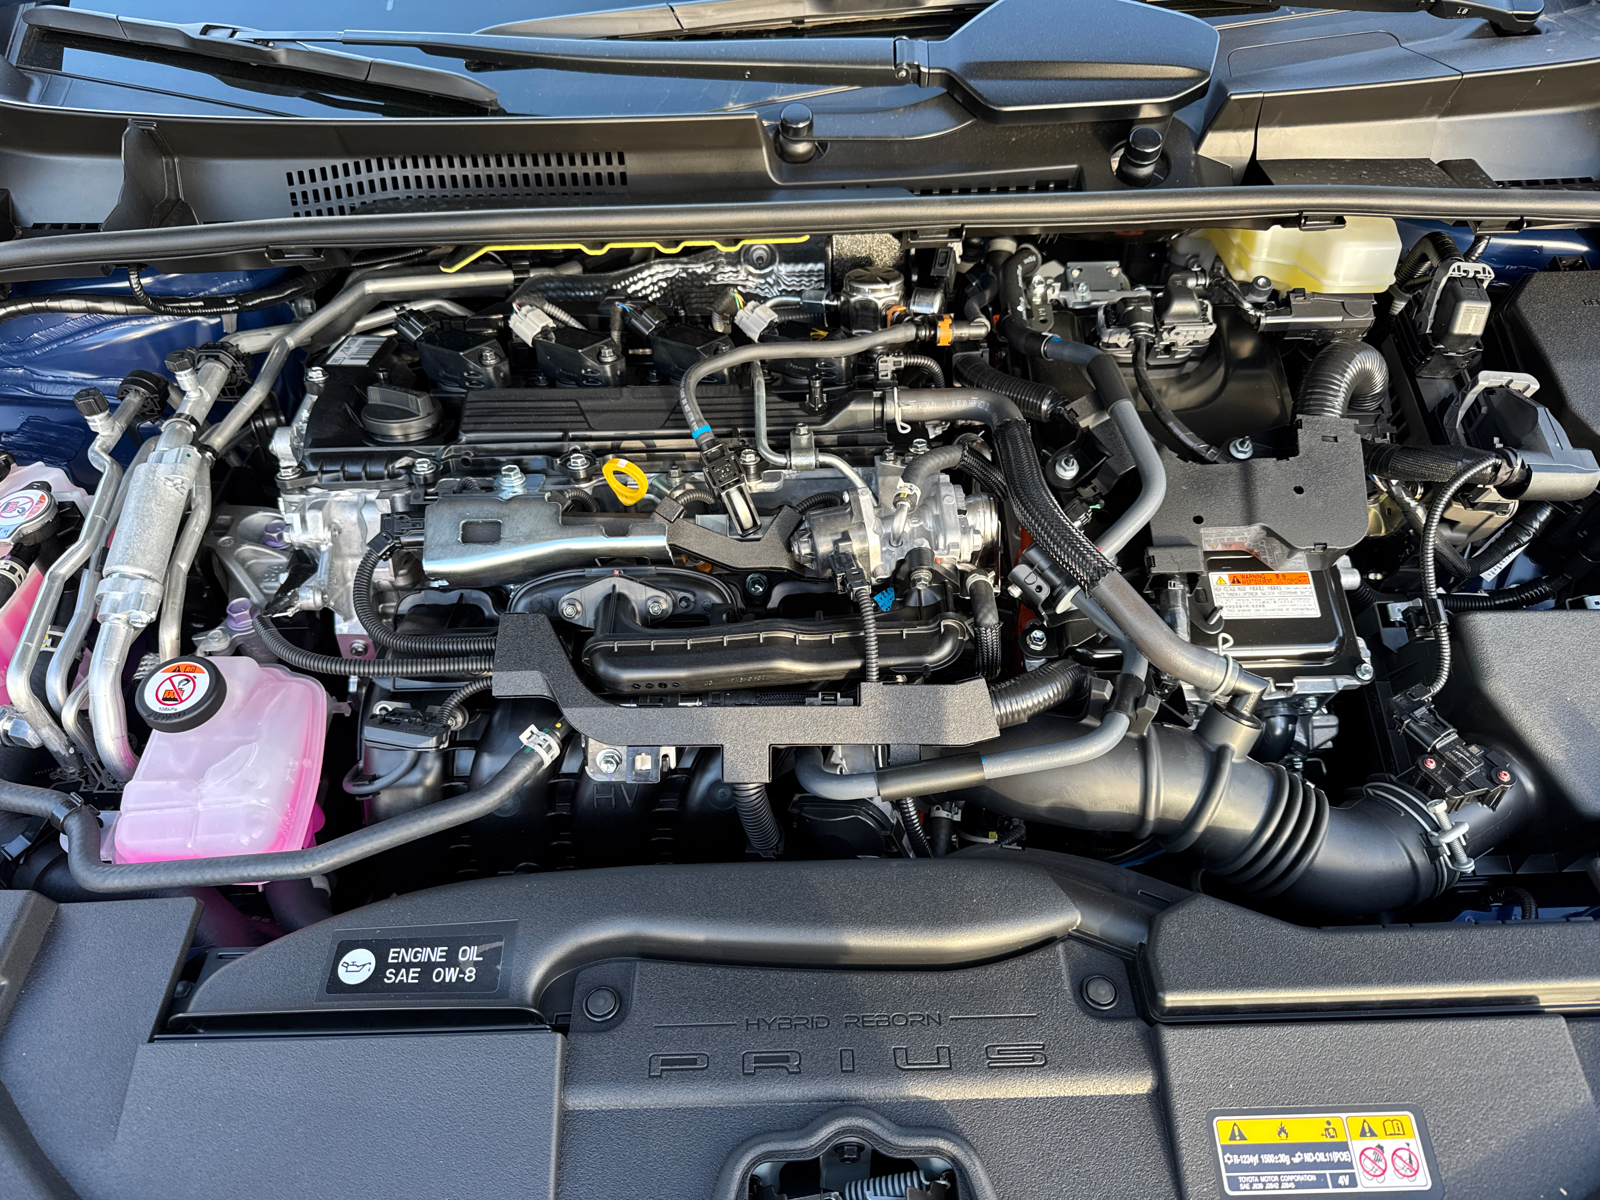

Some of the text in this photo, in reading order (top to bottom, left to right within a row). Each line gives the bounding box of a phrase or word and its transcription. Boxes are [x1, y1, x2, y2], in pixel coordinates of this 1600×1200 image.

[592, 783, 640, 810] HV
[388, 945, 484, 963] ENGINE OIL
[383, 967, 477, 984] SAE 0W-8
[745, 1012, 943, 1032] HYBRID REBORN
[648, 1041, 1048, 1079] PRIUS
[1238, 1175, 1259, 1183] TOYOTA
[1280, 1174, 1317, 1182] CORPORATION
[1337, 1174, 1350, 1186] 4V
